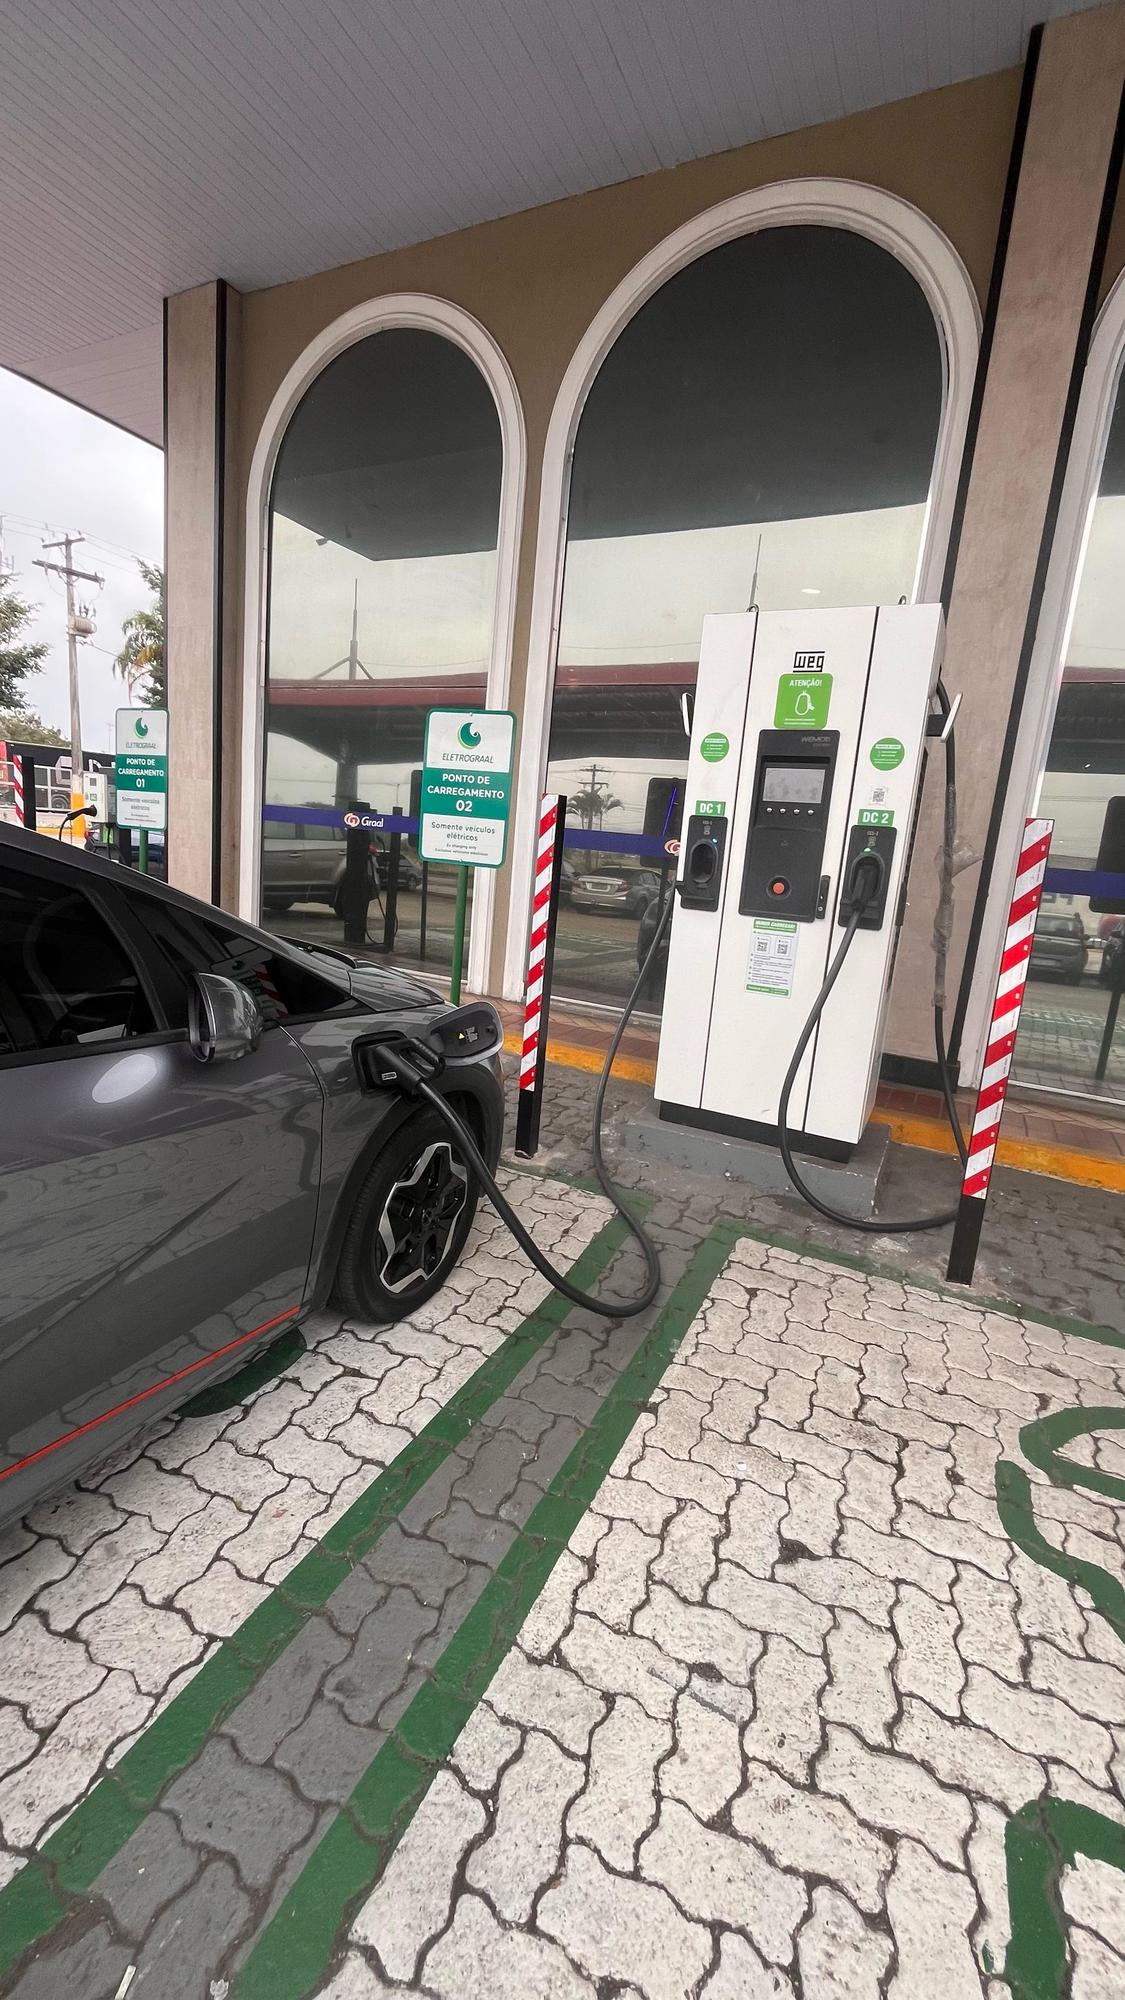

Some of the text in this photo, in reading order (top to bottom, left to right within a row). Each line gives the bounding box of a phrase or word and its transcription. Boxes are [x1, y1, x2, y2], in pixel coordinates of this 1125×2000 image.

[789, 678, 823, 688] ATENÇÃO!
[442, 753, 494, 764] ELETROGRAAL
[118, 768, 164, 777] CARREGAMENTO
[136, 779, 145, 788] 01
[442, 773, 490, 784] PONTO DE
[427, 785, 505, 799] CARREGAMENTO
[456, 800, 473, 812] 02
[699, 803, 722, 814] DC 1
[361, 816, 384, 827] Graal
[862, 812, 889, 824] DC 2
[431, 822, 495, 834] Somente veículos
[446, 832, 478, 842] elétricos
